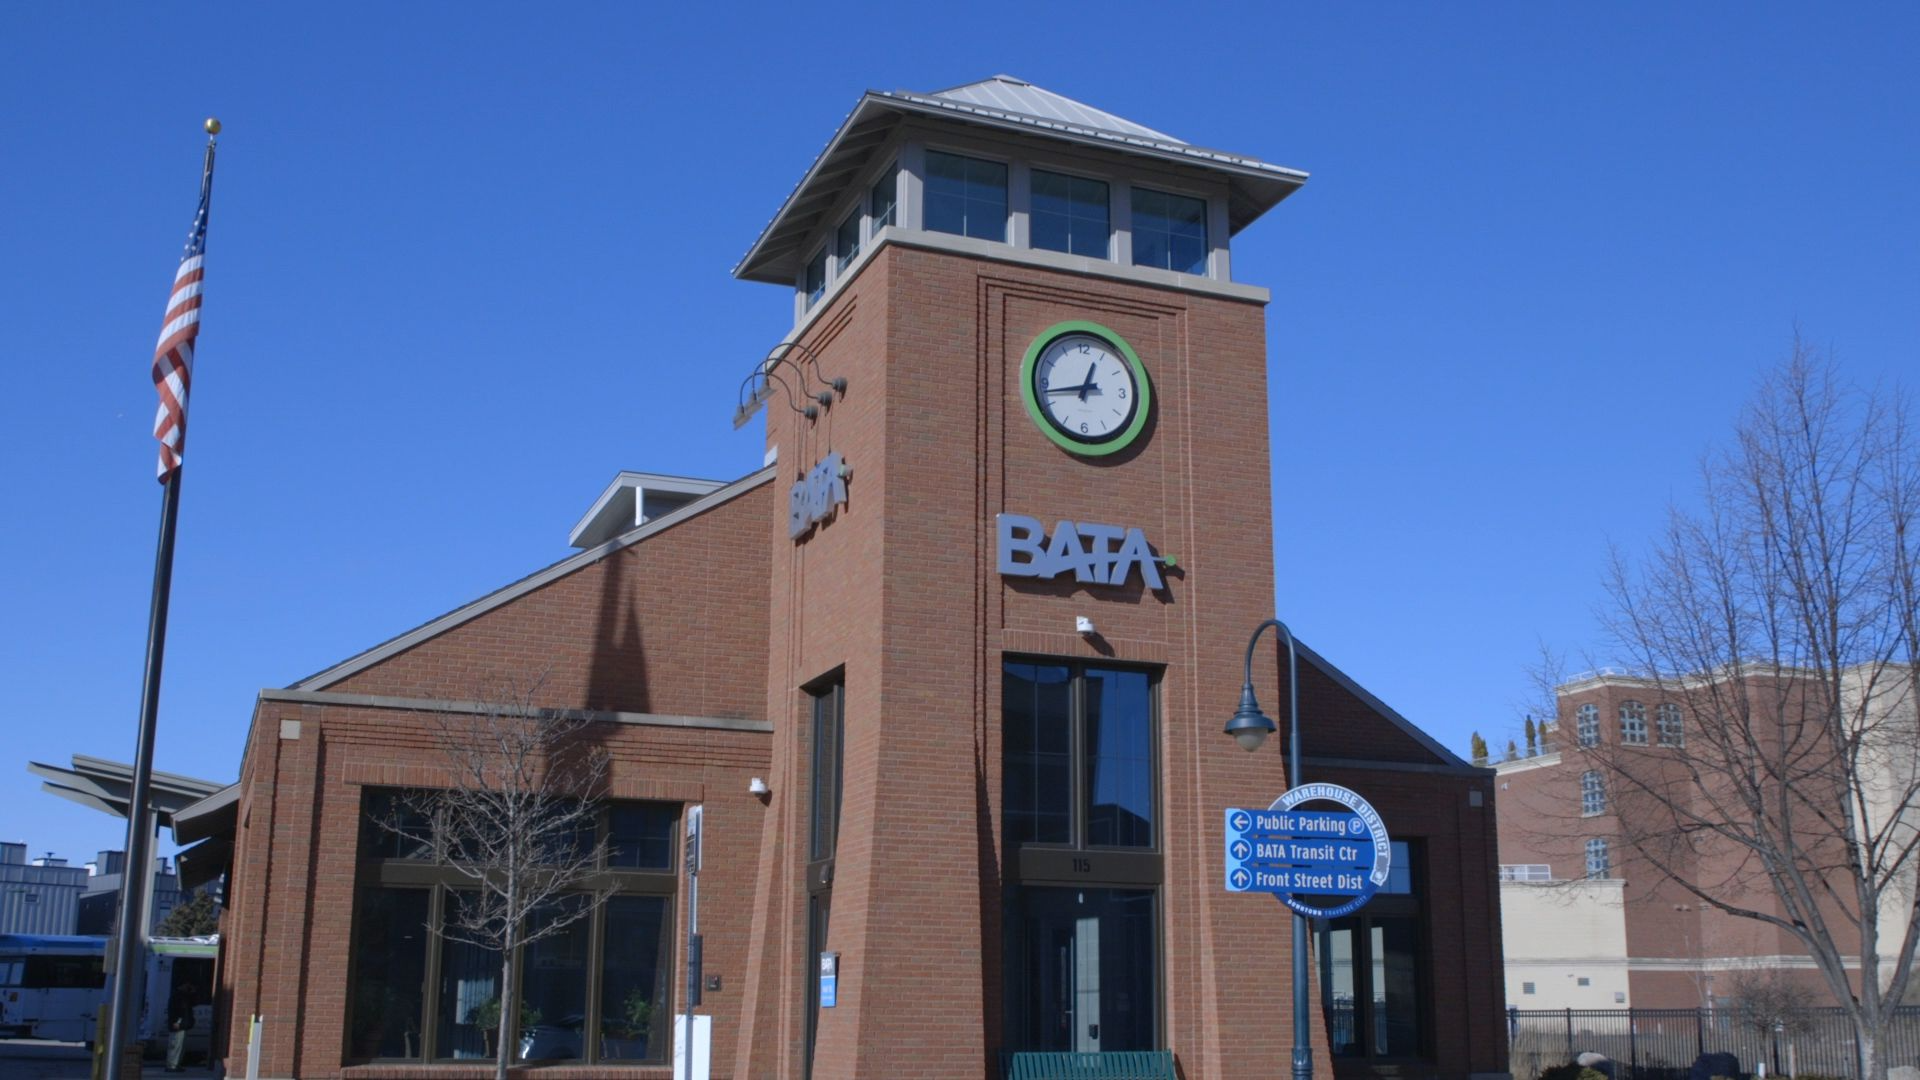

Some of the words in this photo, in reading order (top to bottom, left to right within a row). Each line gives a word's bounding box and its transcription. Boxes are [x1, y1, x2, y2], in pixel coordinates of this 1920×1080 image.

[1078, 343, 1090, 355] 12
[1041, 377, 1049, 389] 9
[1118, 388, 1126, 399] 3
[1080, 422, 1089, 434] 6
[996, 513, 1164, 589] BATA
[1256, 815, 1295, 831] Public
[1299, 817, 1346, 836] Parking
[1282, 786, 1358, 807] WAREHOUSE
[1358, 801, 1388, 859] DISTRICT
[1256, 843, 1286, 859] BATA
[1290, 844, 1335, 861] Transit
[1339, 846, 1358, 861] Ctr
[1072, 858, 1090, 873] 115
[1256, 872, 1290, 888] Front
[1294, 873, 1333, 889] Street
[1338, 874, 1363, 890] Dist
[1287, 898, 1322, 916] DOWNTOWN
